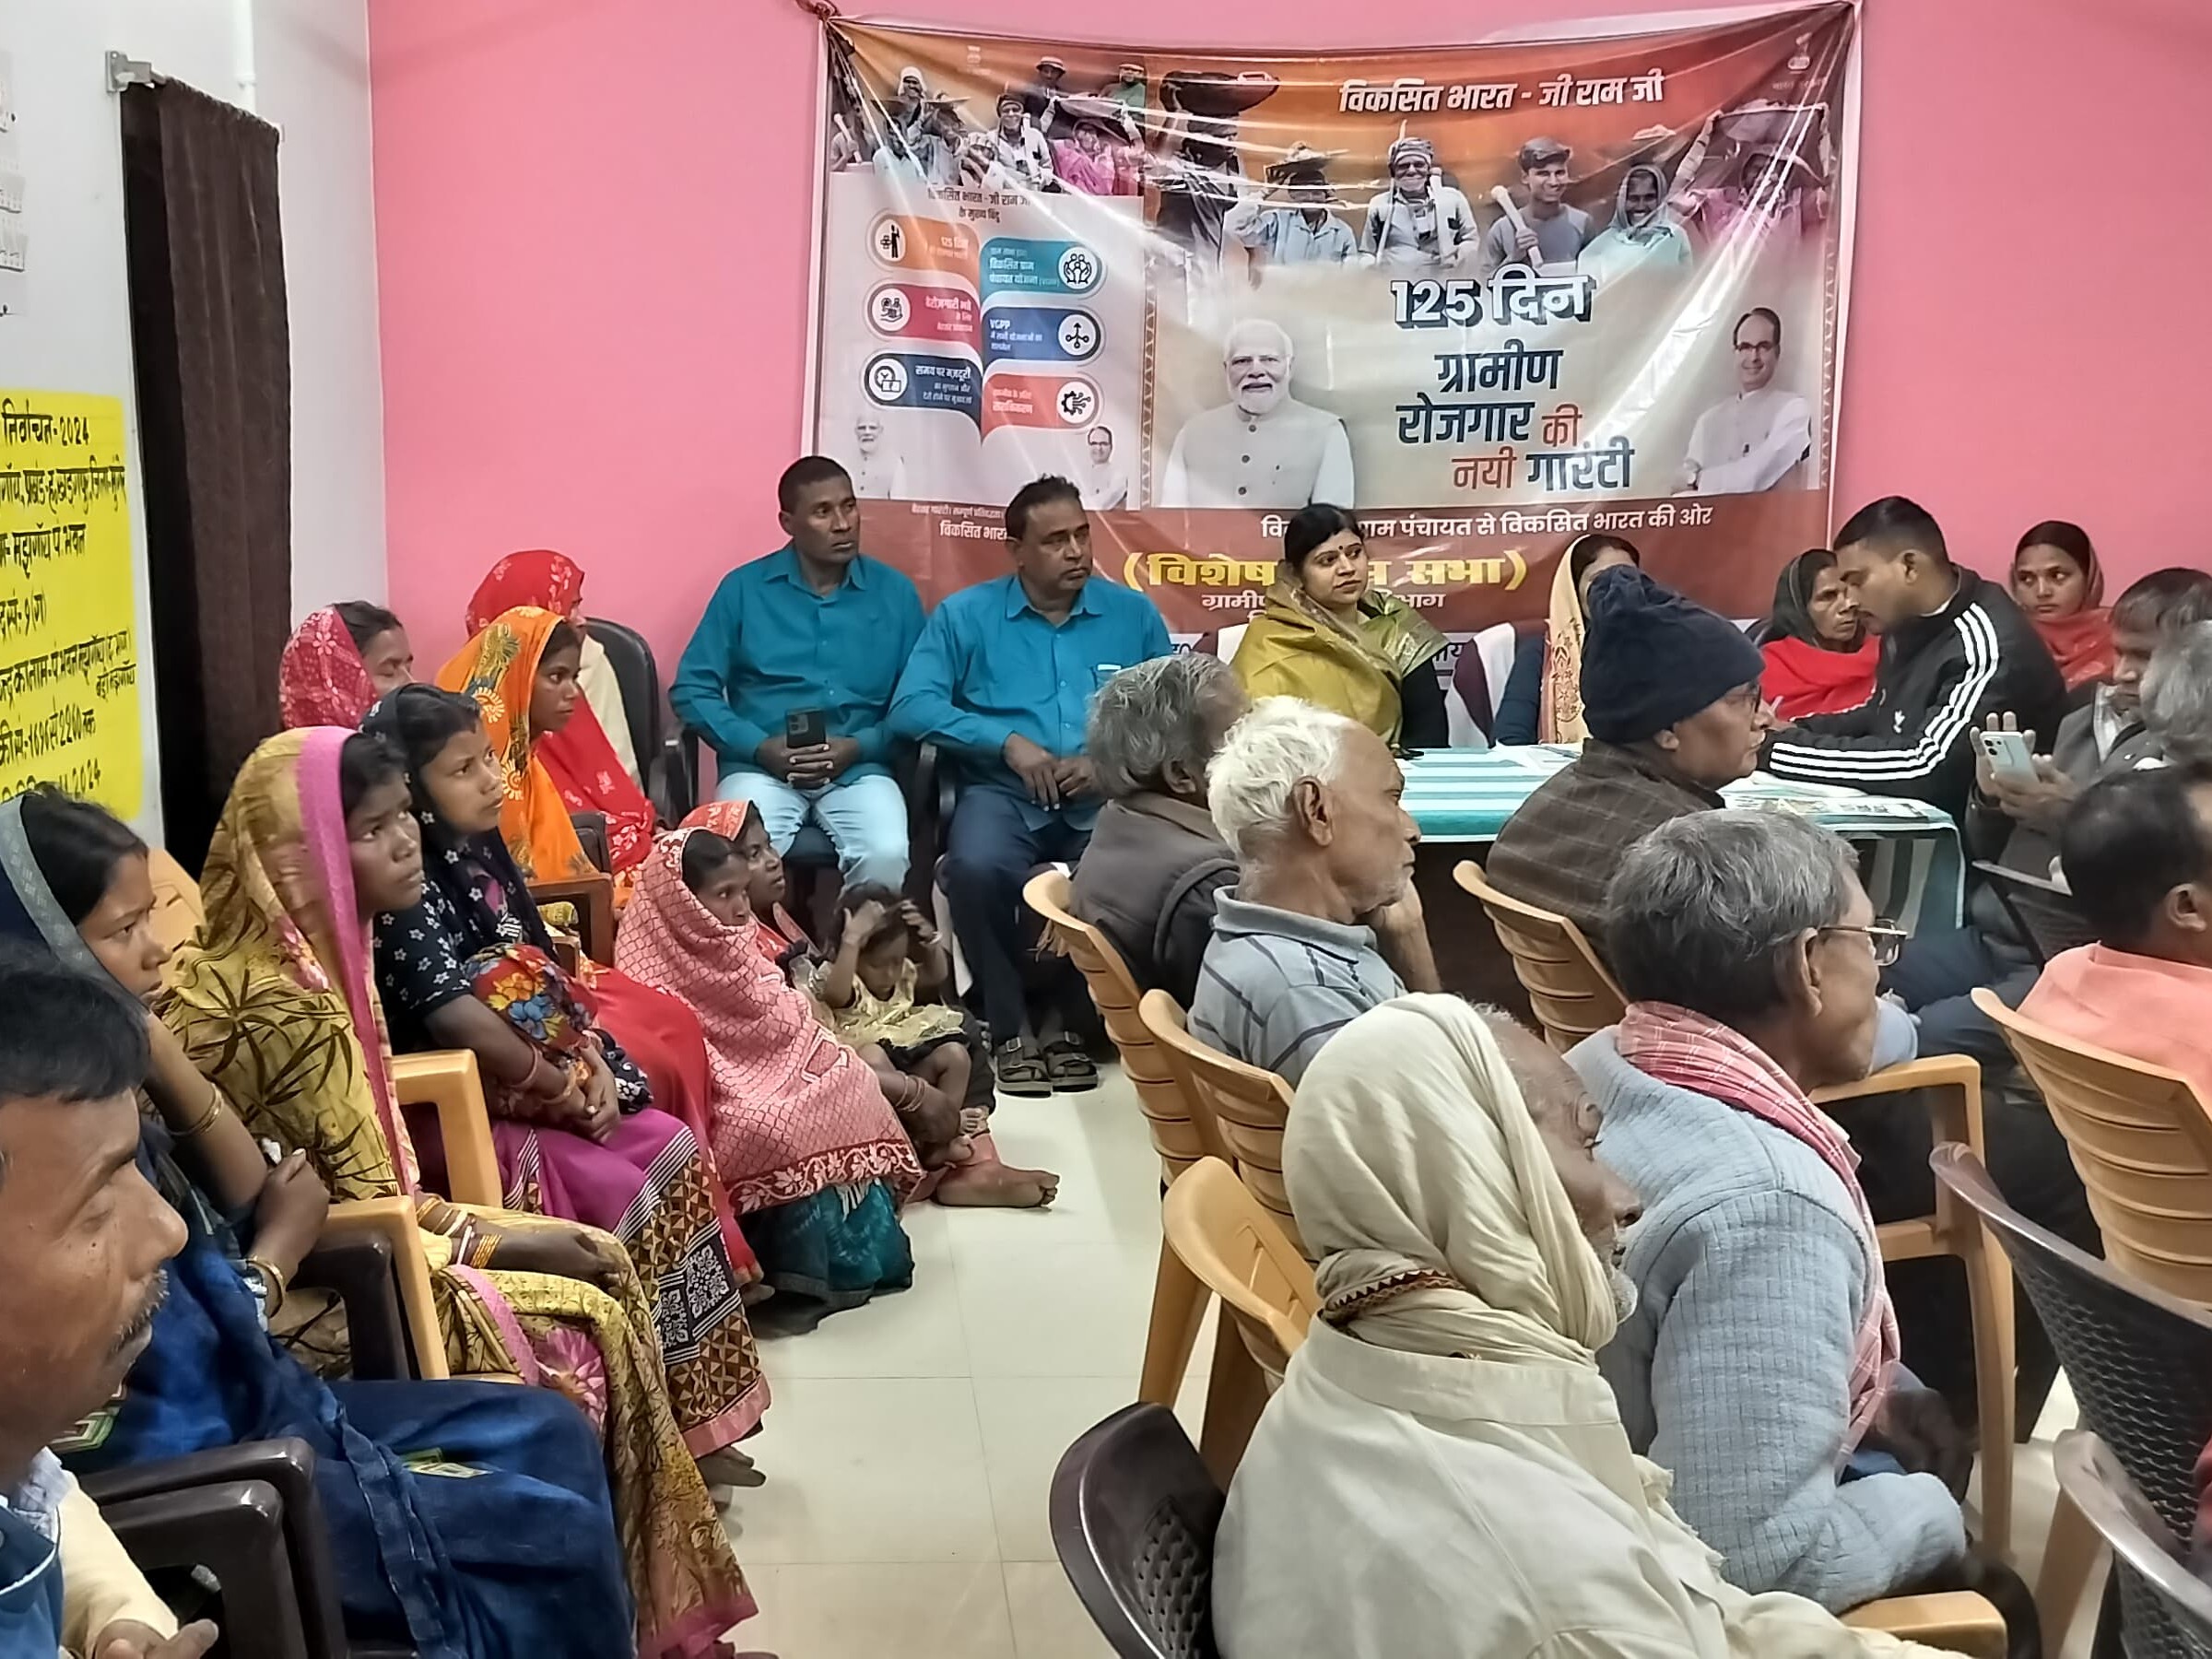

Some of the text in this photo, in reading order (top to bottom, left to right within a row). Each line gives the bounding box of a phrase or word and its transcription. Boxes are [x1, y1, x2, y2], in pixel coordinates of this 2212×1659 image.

[1338, 78, 1444, 112] विकसित
[1446, 83, 1517, 111] भारत
[1538, 74, 1571, 107] जी
[1575, 76, 1627, 104] राम
[1630, 67, 1664, 102] जी
[962, 191, 982, 203] भारत
[1001, 194, 1018, 206] राम
[1391, 263, 1596, 329] 125 दिन
[1434, 339, 1563, 393] ग्रामीण
[1395, 392, 1583, 447] रोजगार की
[1452, 436, 1635, 491] नयी गारंटी
[939, 519, 982, 539] विकसित
[1400, 515, 1473, 537] पंचायत
[1476, 512, 1497, 535] से
[1500, 510, 1589, 535] विकसित
[1593, 511, 1645, 531] भारत
[1648, 503, 1676, 527] की
[1679, 502, 1713, 526] ओर
